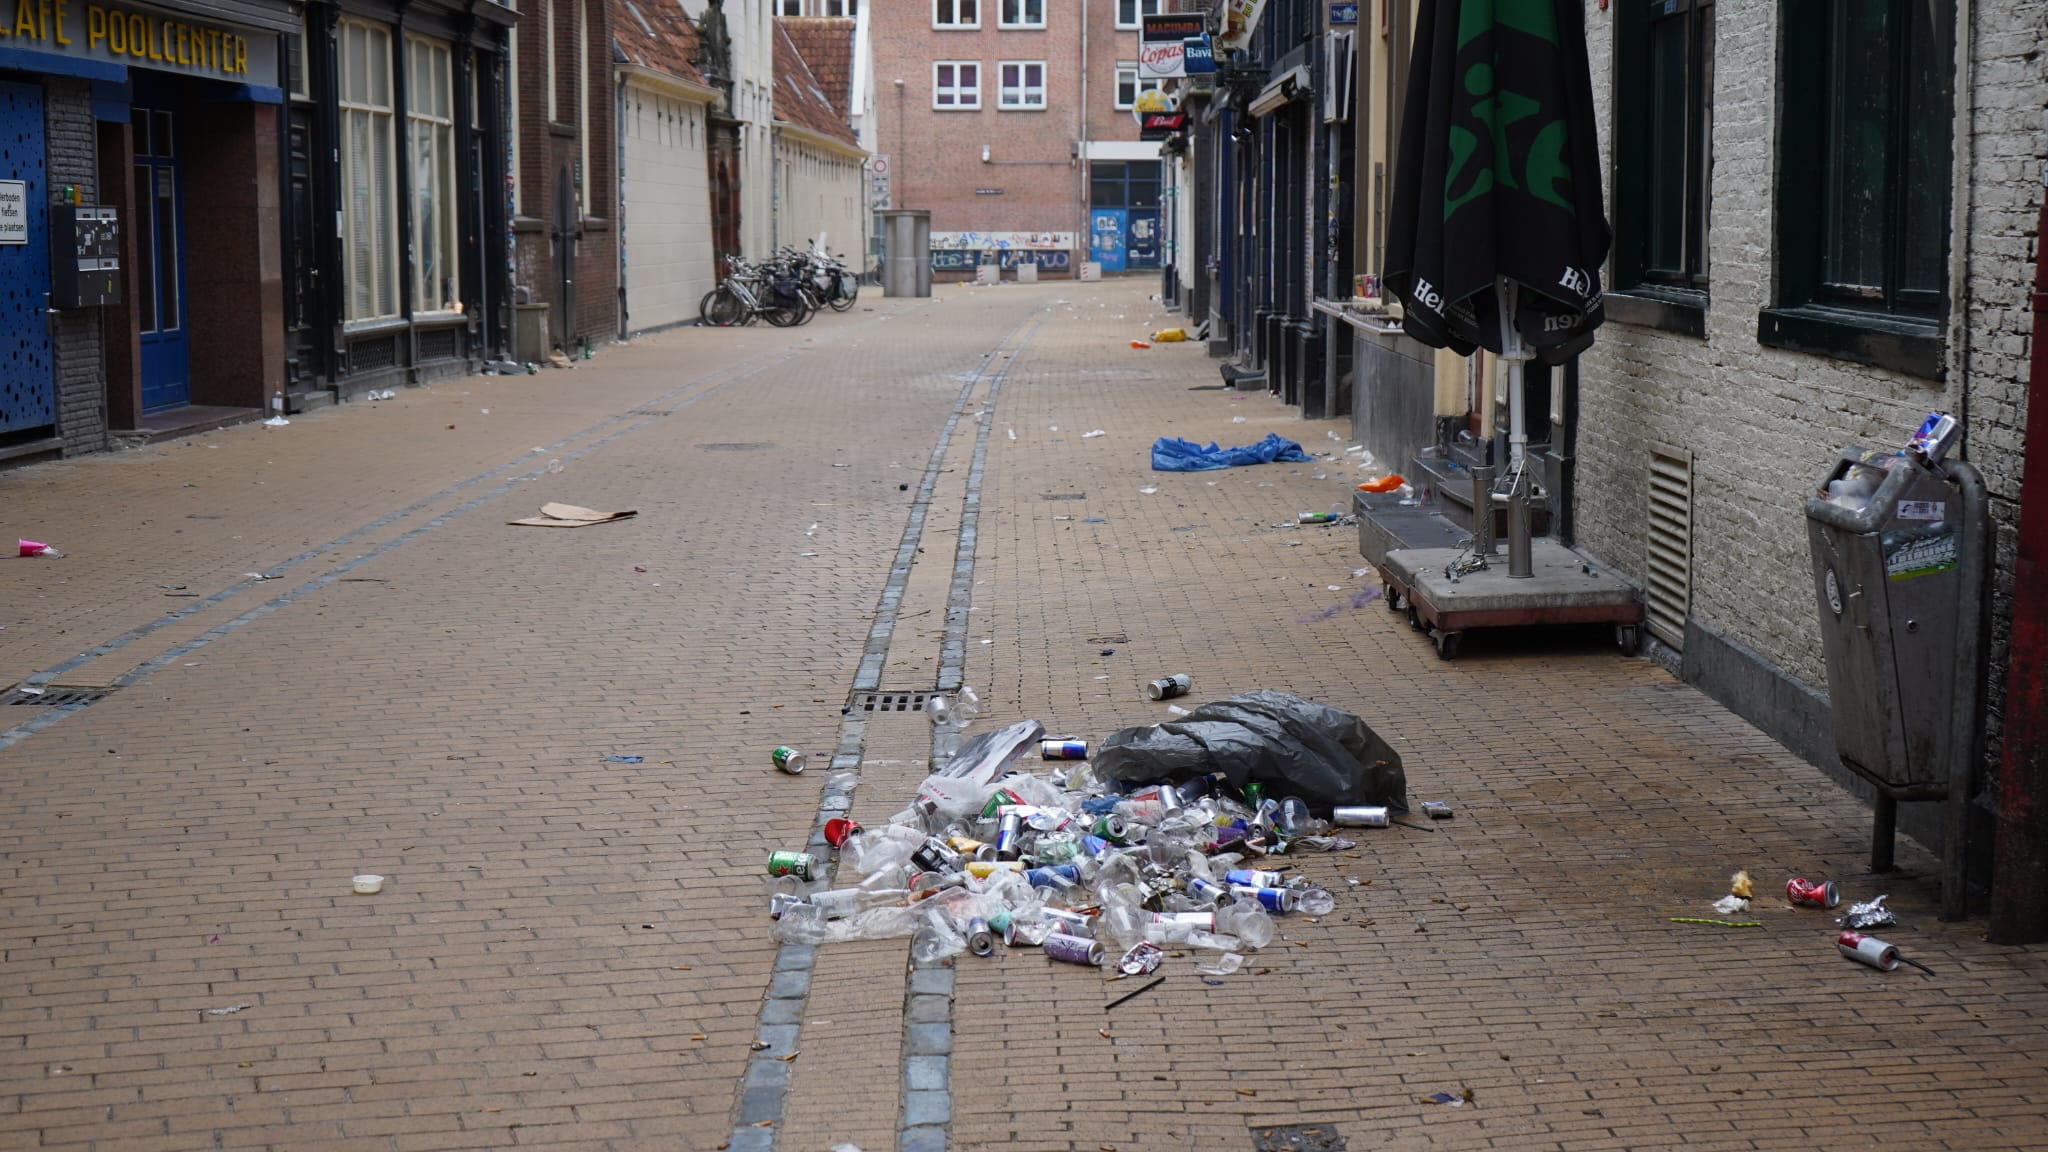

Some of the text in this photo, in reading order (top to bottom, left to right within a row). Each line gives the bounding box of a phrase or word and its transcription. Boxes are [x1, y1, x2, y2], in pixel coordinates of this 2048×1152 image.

[1146, 22, 1201, 33] MACUMBA
[88, 5, 248, 74] POOLCENTER
[1140, 44, 1184, 64] Copas
[1, 207, 18, 217] fietsen
[4, 223, 24, 233] plaatsen
